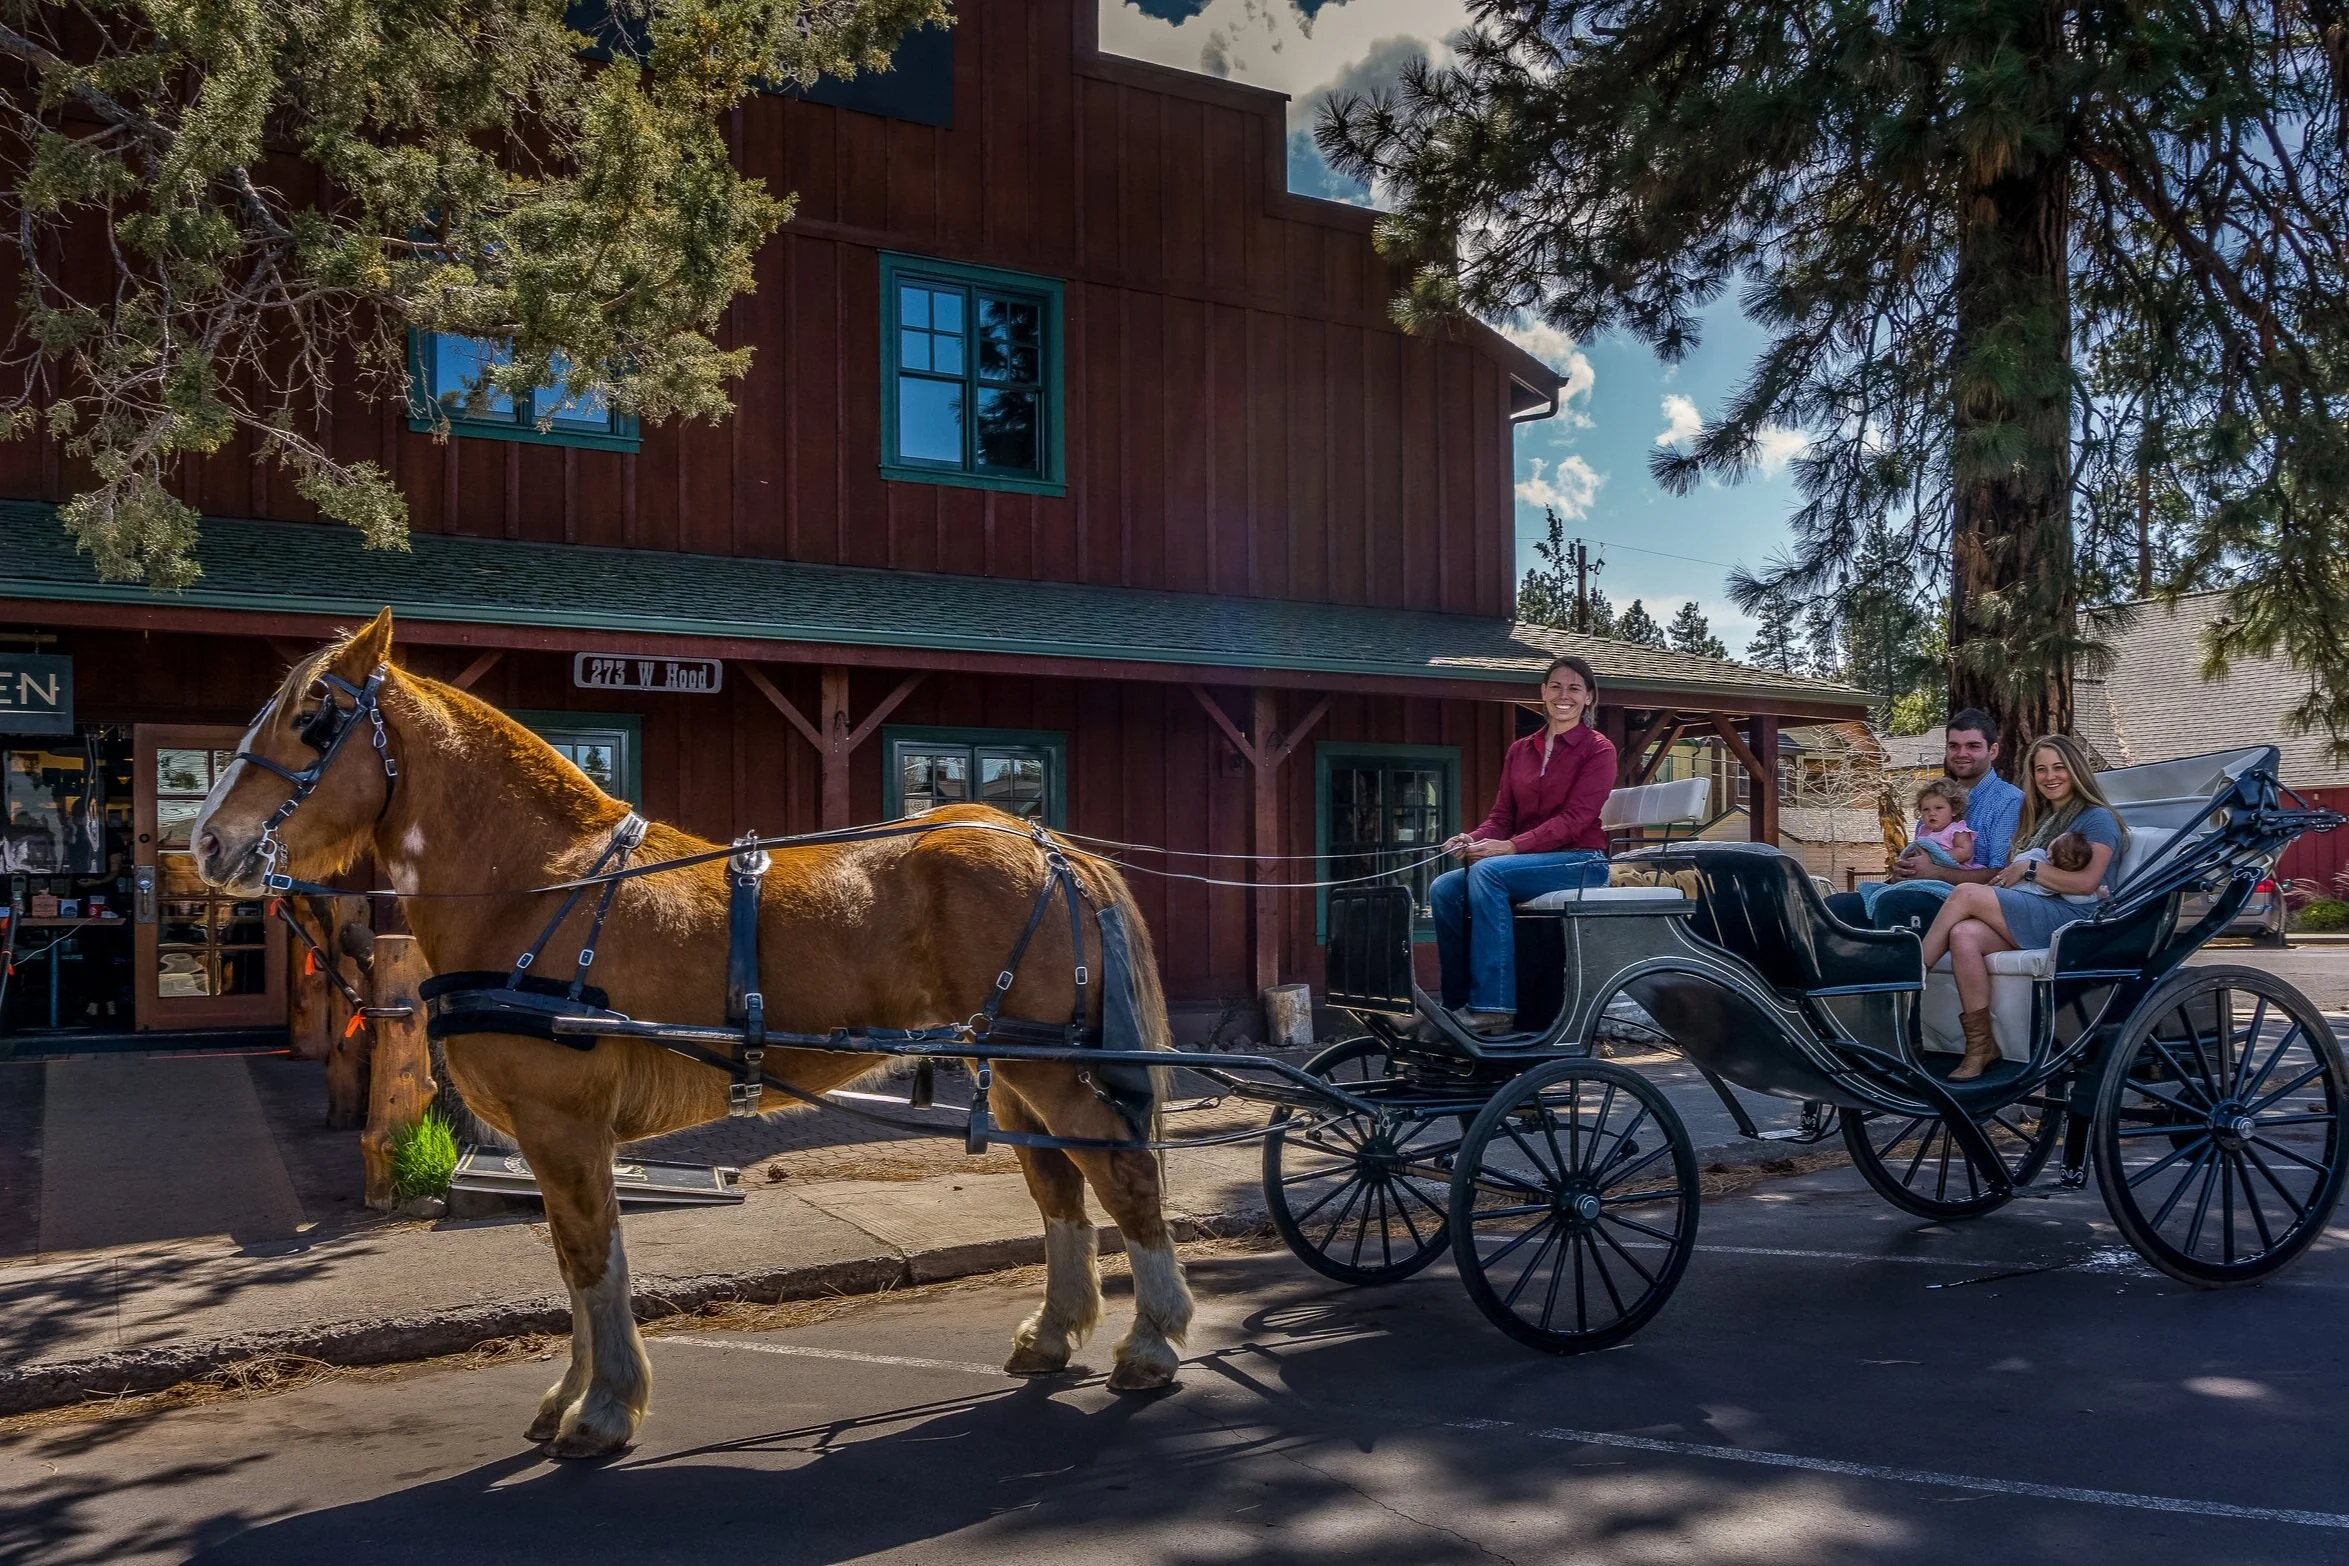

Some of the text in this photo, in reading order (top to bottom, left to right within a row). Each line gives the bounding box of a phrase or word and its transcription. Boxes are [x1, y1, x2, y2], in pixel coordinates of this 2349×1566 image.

[591, 659, 707, 689] 273 W Hood
